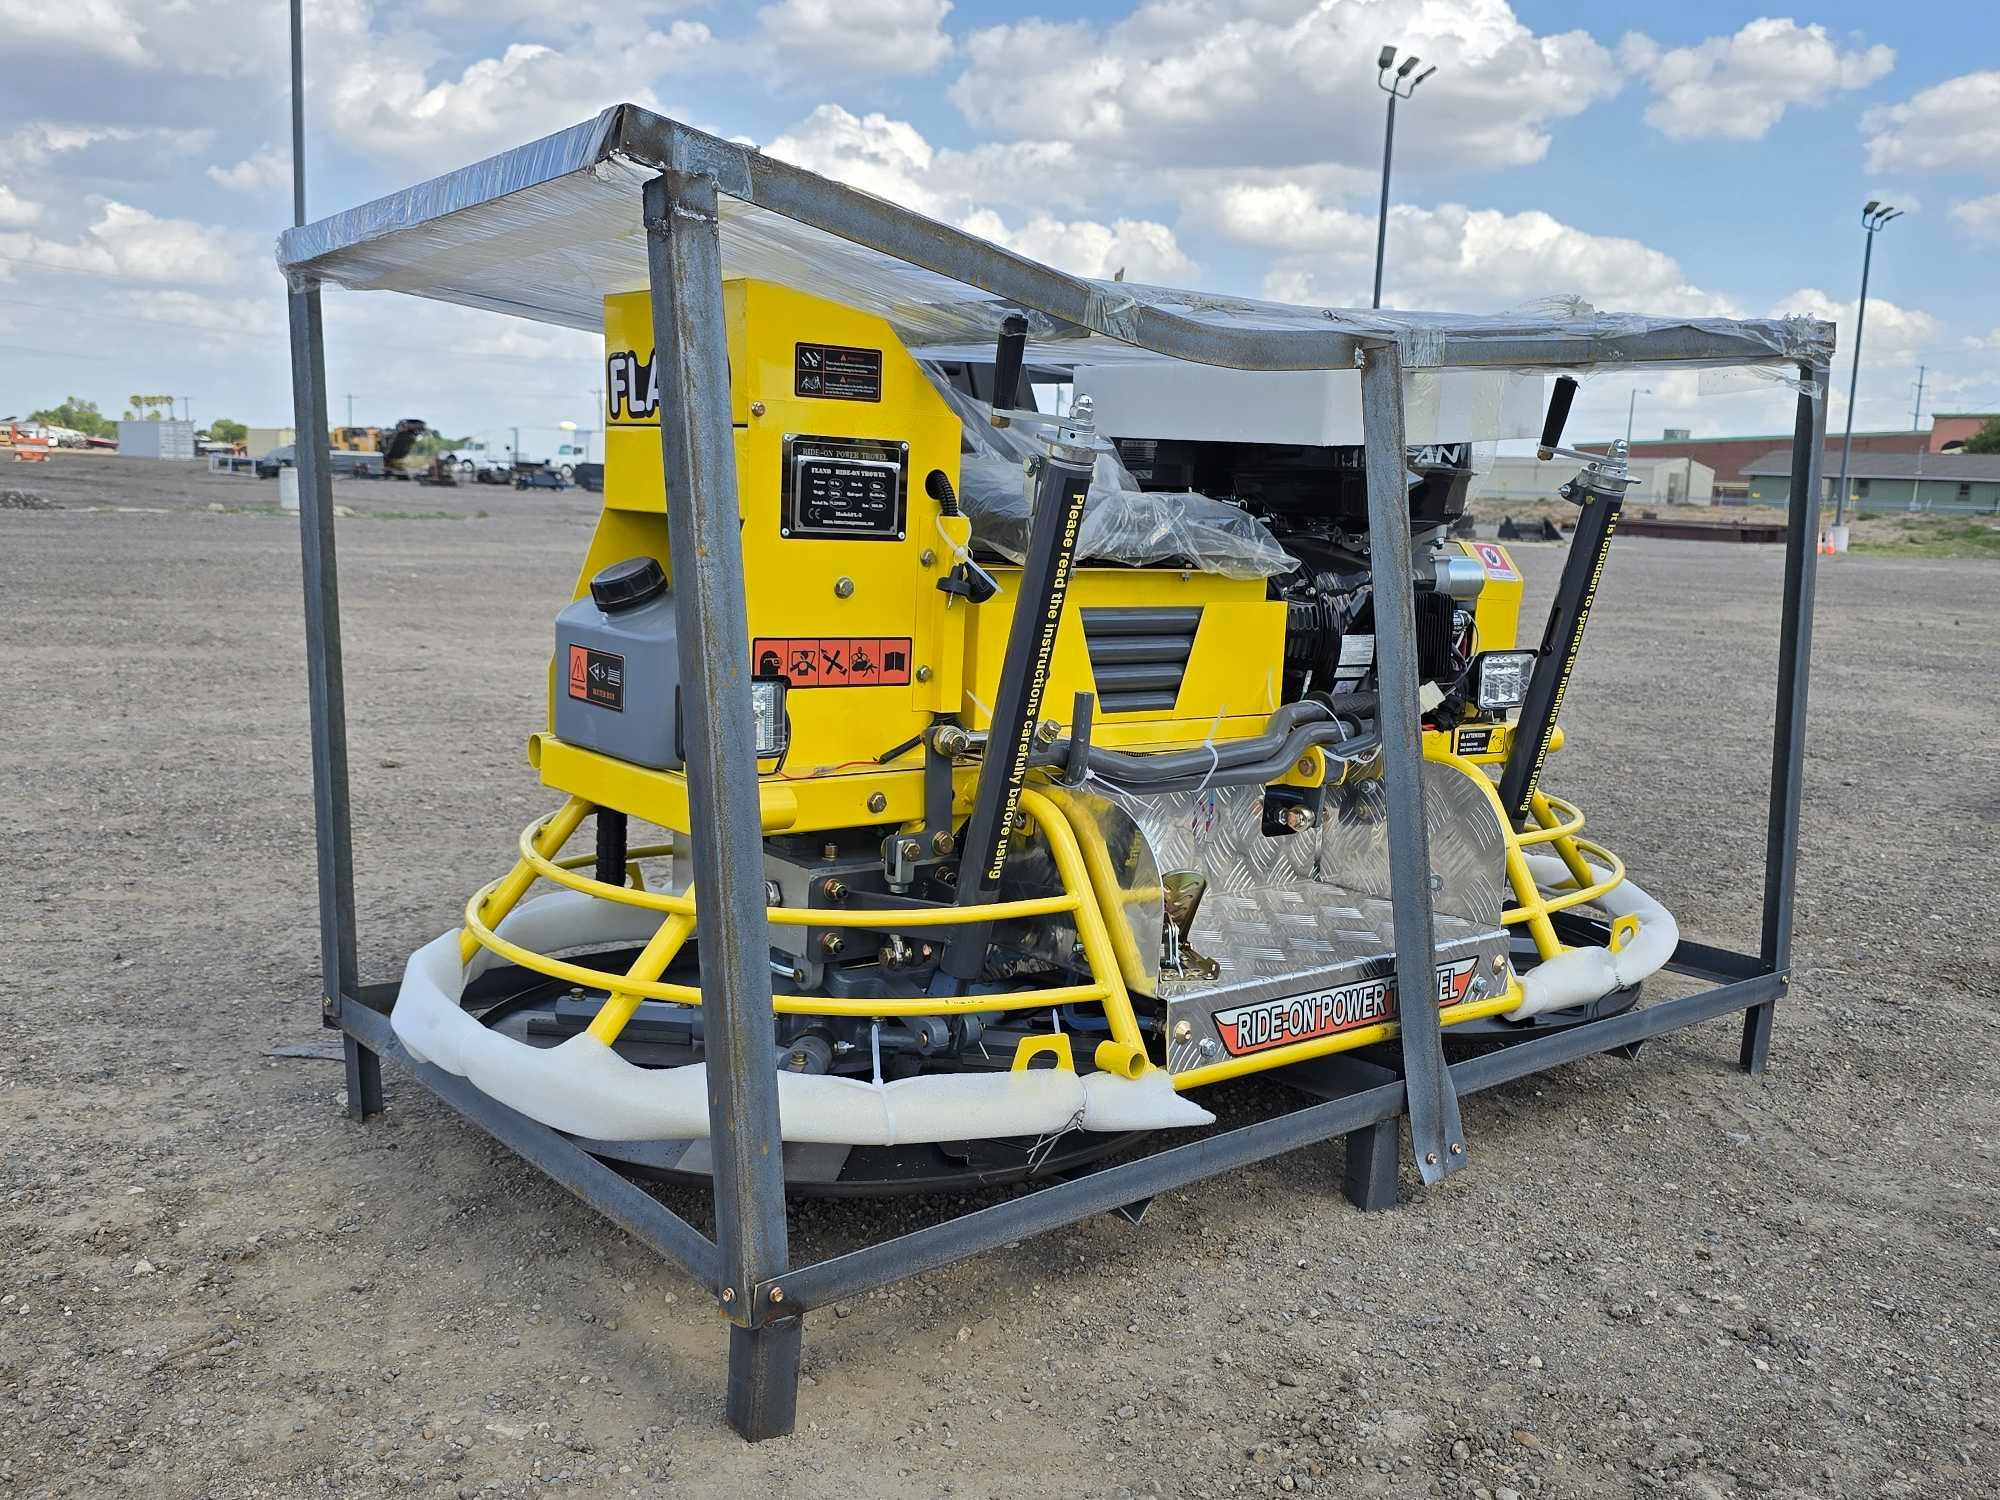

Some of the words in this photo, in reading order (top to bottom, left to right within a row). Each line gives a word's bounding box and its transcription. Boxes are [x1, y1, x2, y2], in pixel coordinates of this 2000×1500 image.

[608, 350, 661, 419] FLA
[801, 447, 834, 457] RIDE-ON
[836, 450, 859, 459] POWER
[862, 452, 888, 461] TROWEL
[1062, 494, 1085, 548] Please
[1606, 524, 1616, 534] is
[1610, 512, 1620, 522] It
[1054, 552, 1070, 589] read
[1589, 537, 1612, 592] forbidden
[1047, 591, 1063, 620] the
[1584, 594, 1594, 608] to
[1570, 610, 1588, 653] operate
[1026, 623, 1057, 717] instructions
[1564, 656, 1575, 674] the
[1549, 676, 1569, 723] machine
[1009, 720, 1034, 785] carefully
[1535, 725, 1554, 769] without
[1000, 788, 1021, 836] before
[1519, 770, 1540, 811] training
[988, 839, 1008, 880] using
[1236, 997, 1316, 1050] RIDE-ON
[1319, 982, 1387, 1030] POWER
